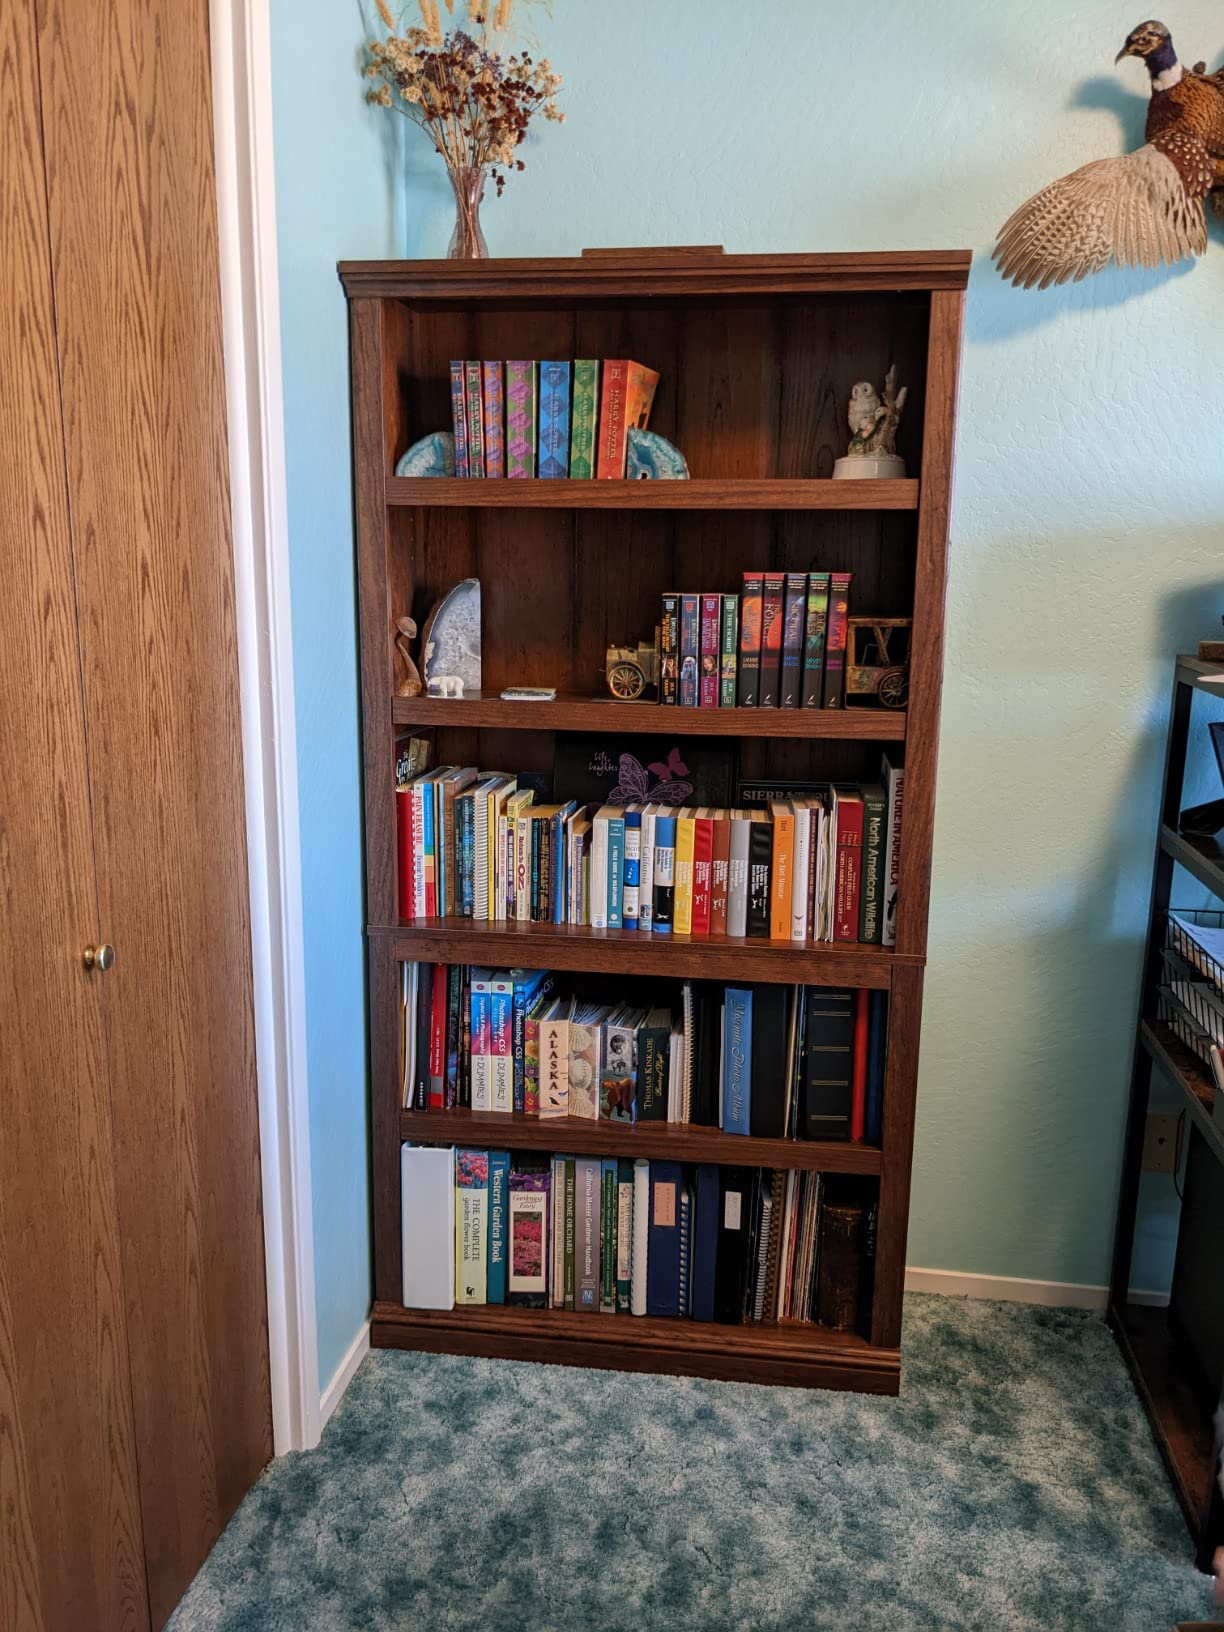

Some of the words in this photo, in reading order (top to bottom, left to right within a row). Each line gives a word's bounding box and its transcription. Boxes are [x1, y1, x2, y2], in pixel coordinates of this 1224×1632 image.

[894, 777, 903, 821] NATURE
[868, 817, 880, 846] North
[892, 823, 902, 834] IN
[518, 864, 525, 890] OZ
[642, 846, 650, 884] California
[866, 848, 879, 901] American
[890, 836, 901, 885] AMERICA
[864, 902, 876, 939] Wildlife
[515, 1009, 523, 1045] Photoshop
[549, 1030, 558, 1090] ALASKA
[731, 1047, 745, 1081] Photo
[476, 1061, 484, 1099] DUMMIES
[644, 1076, 652, 1110] THOMAS
[732, 1084, 742, 1122] Album
[492, 1169, 503, 1204] Western
[585, 1168, 595, 1196] California
[472, 1217, 480, 1262] COMPLETE
[492, 1206, 502, 1238] Garden
[492, 1240, 502, 1263] Book
